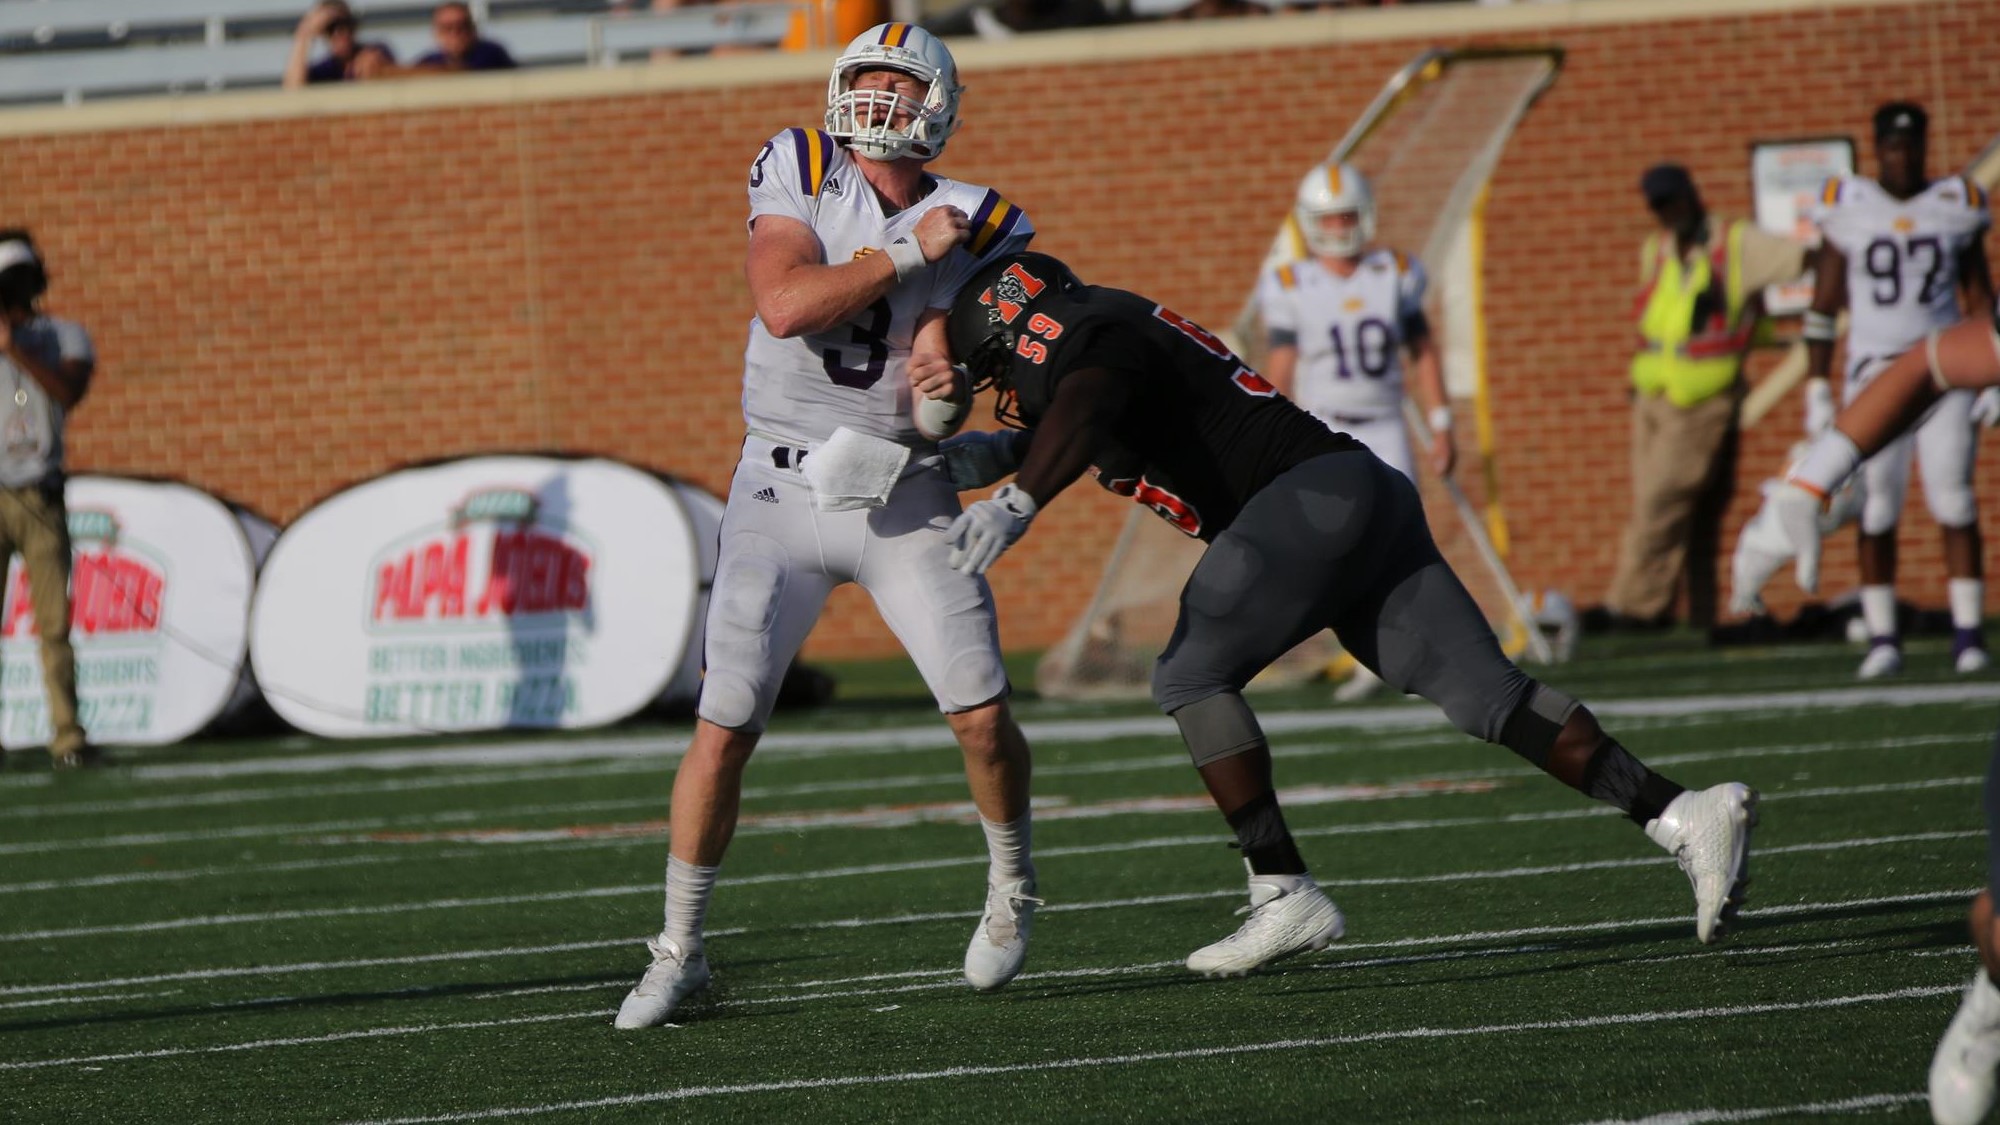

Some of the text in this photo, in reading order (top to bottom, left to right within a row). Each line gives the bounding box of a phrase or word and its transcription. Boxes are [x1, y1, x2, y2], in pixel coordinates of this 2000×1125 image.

[750, 140, 774, 188] 3
[1866, 236, 1943, 306] 97
[822, 295, 893, 391] 3
[1016, 312, 1064, 365] 59
[1330, 318, 1393, 381] 10
